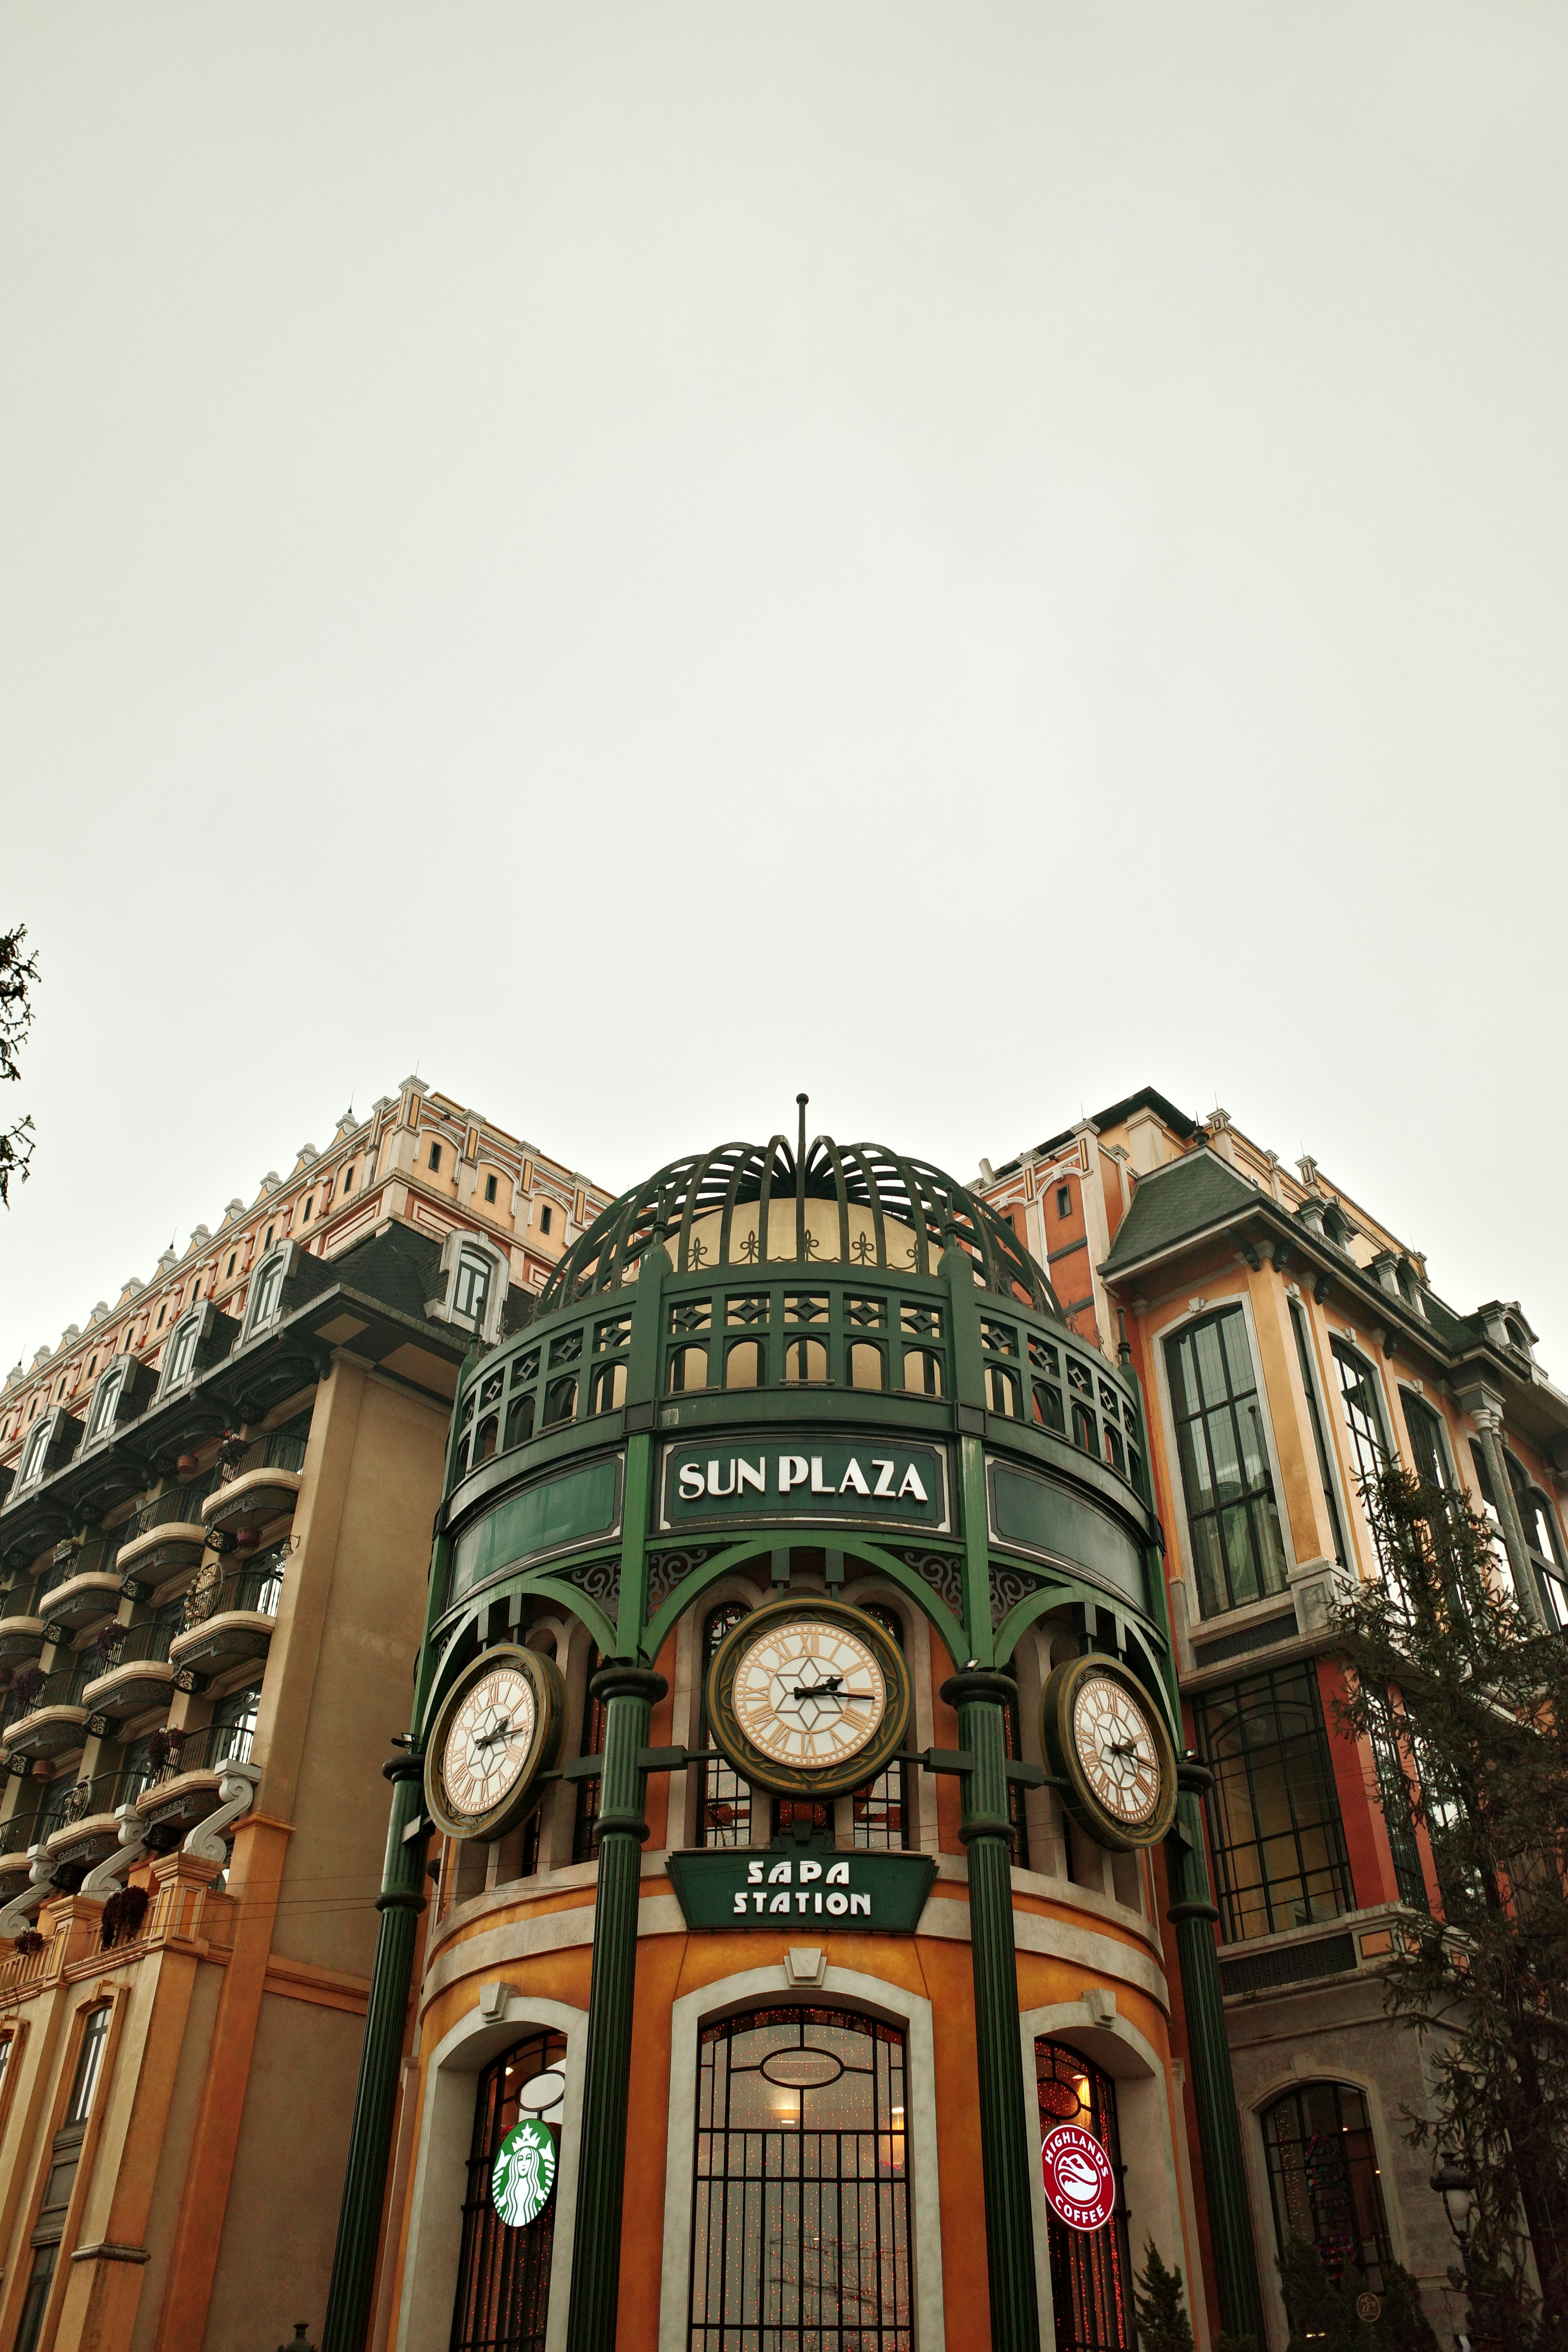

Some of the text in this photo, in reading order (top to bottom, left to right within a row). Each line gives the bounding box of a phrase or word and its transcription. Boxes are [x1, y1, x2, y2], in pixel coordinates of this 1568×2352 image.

[679, 1455, 929, 1503] SUN PLAZA
[747, 1861, 849, 1885] SAPA
[733, 1892, 871, 1916] STATION
[1045, 2131, 1109, 2177] HIGHLANDS
[1055, 2195, 1105, 2224] COFFEE
